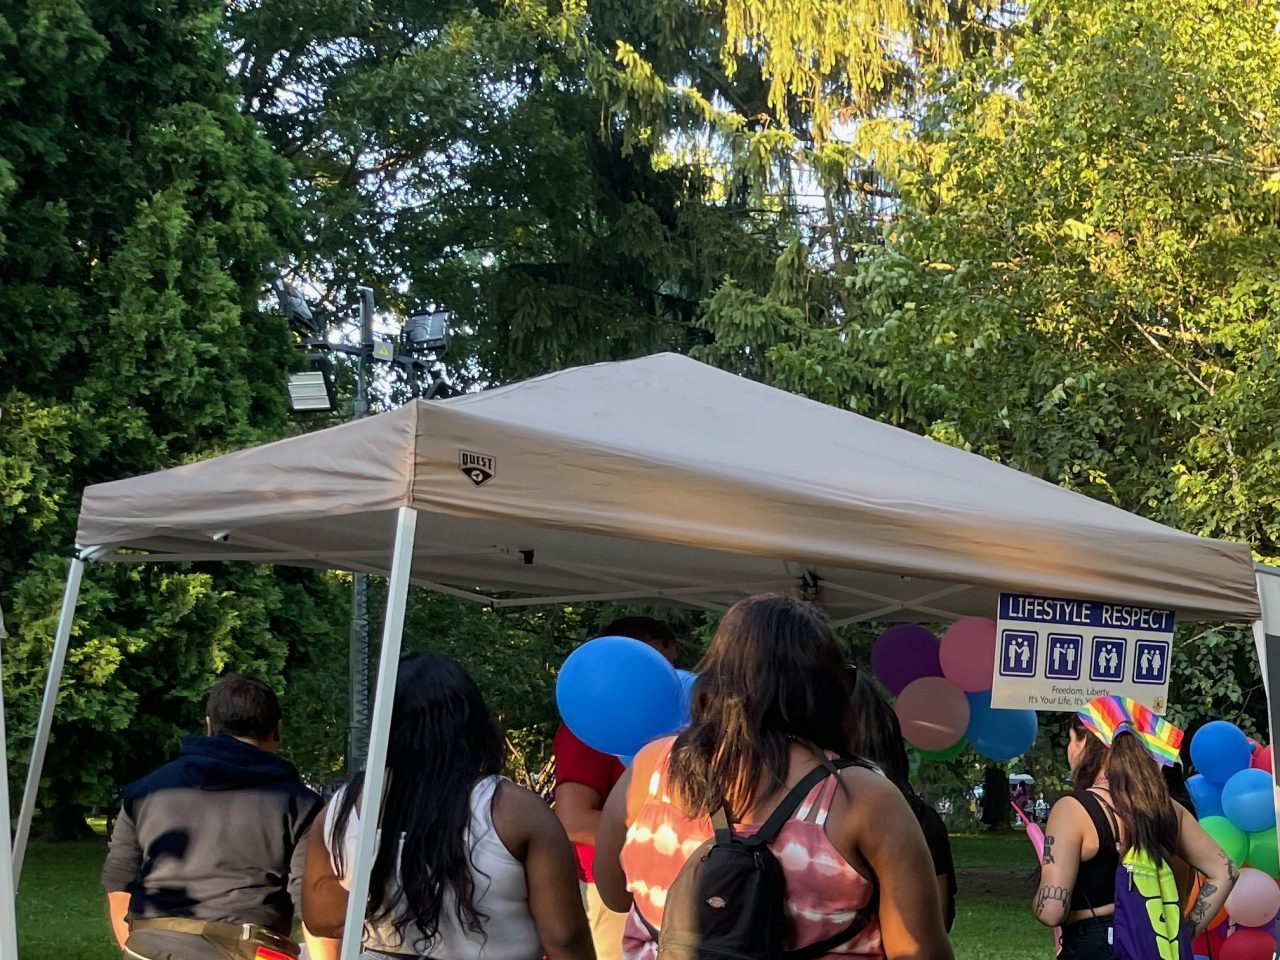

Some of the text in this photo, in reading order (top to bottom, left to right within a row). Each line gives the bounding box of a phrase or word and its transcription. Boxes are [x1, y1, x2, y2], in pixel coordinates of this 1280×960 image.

[462, 453, 493, 470] QUEST
[1008, 596, 1170, 629] LIFESTYLE RESPECT
[1040, 695, 1056, 705] Your
